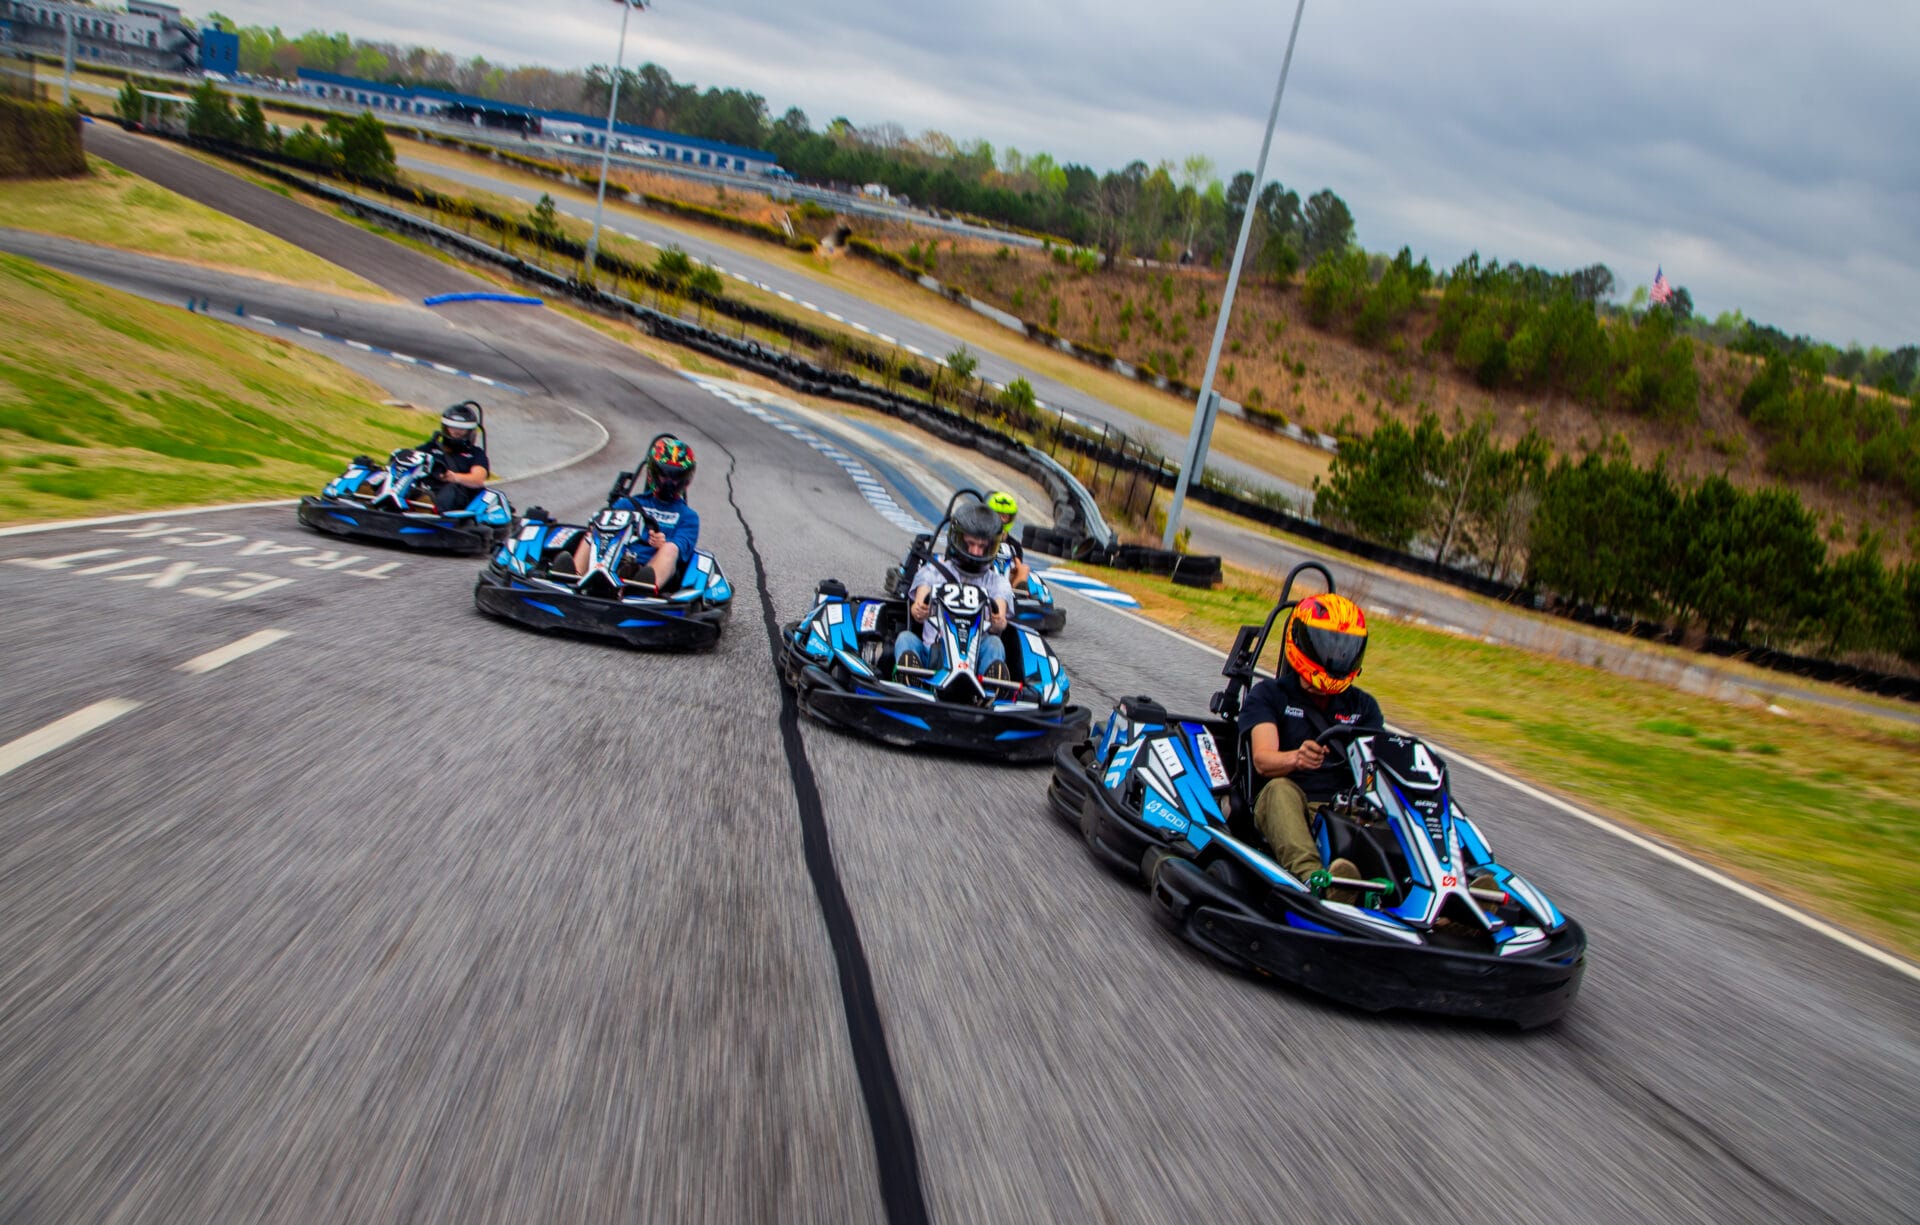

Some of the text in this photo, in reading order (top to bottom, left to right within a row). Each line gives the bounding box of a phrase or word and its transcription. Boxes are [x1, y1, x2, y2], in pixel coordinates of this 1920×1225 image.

[600, 509, 630, 526] 19
[92, 522, 402, 580] TRACK
[2, 548, 299, 600] EXIT
[943, 583, 979, 608] 28
[1410, 743, 1440, 781] 4
[1158, 808, 1187, 830] SODI
